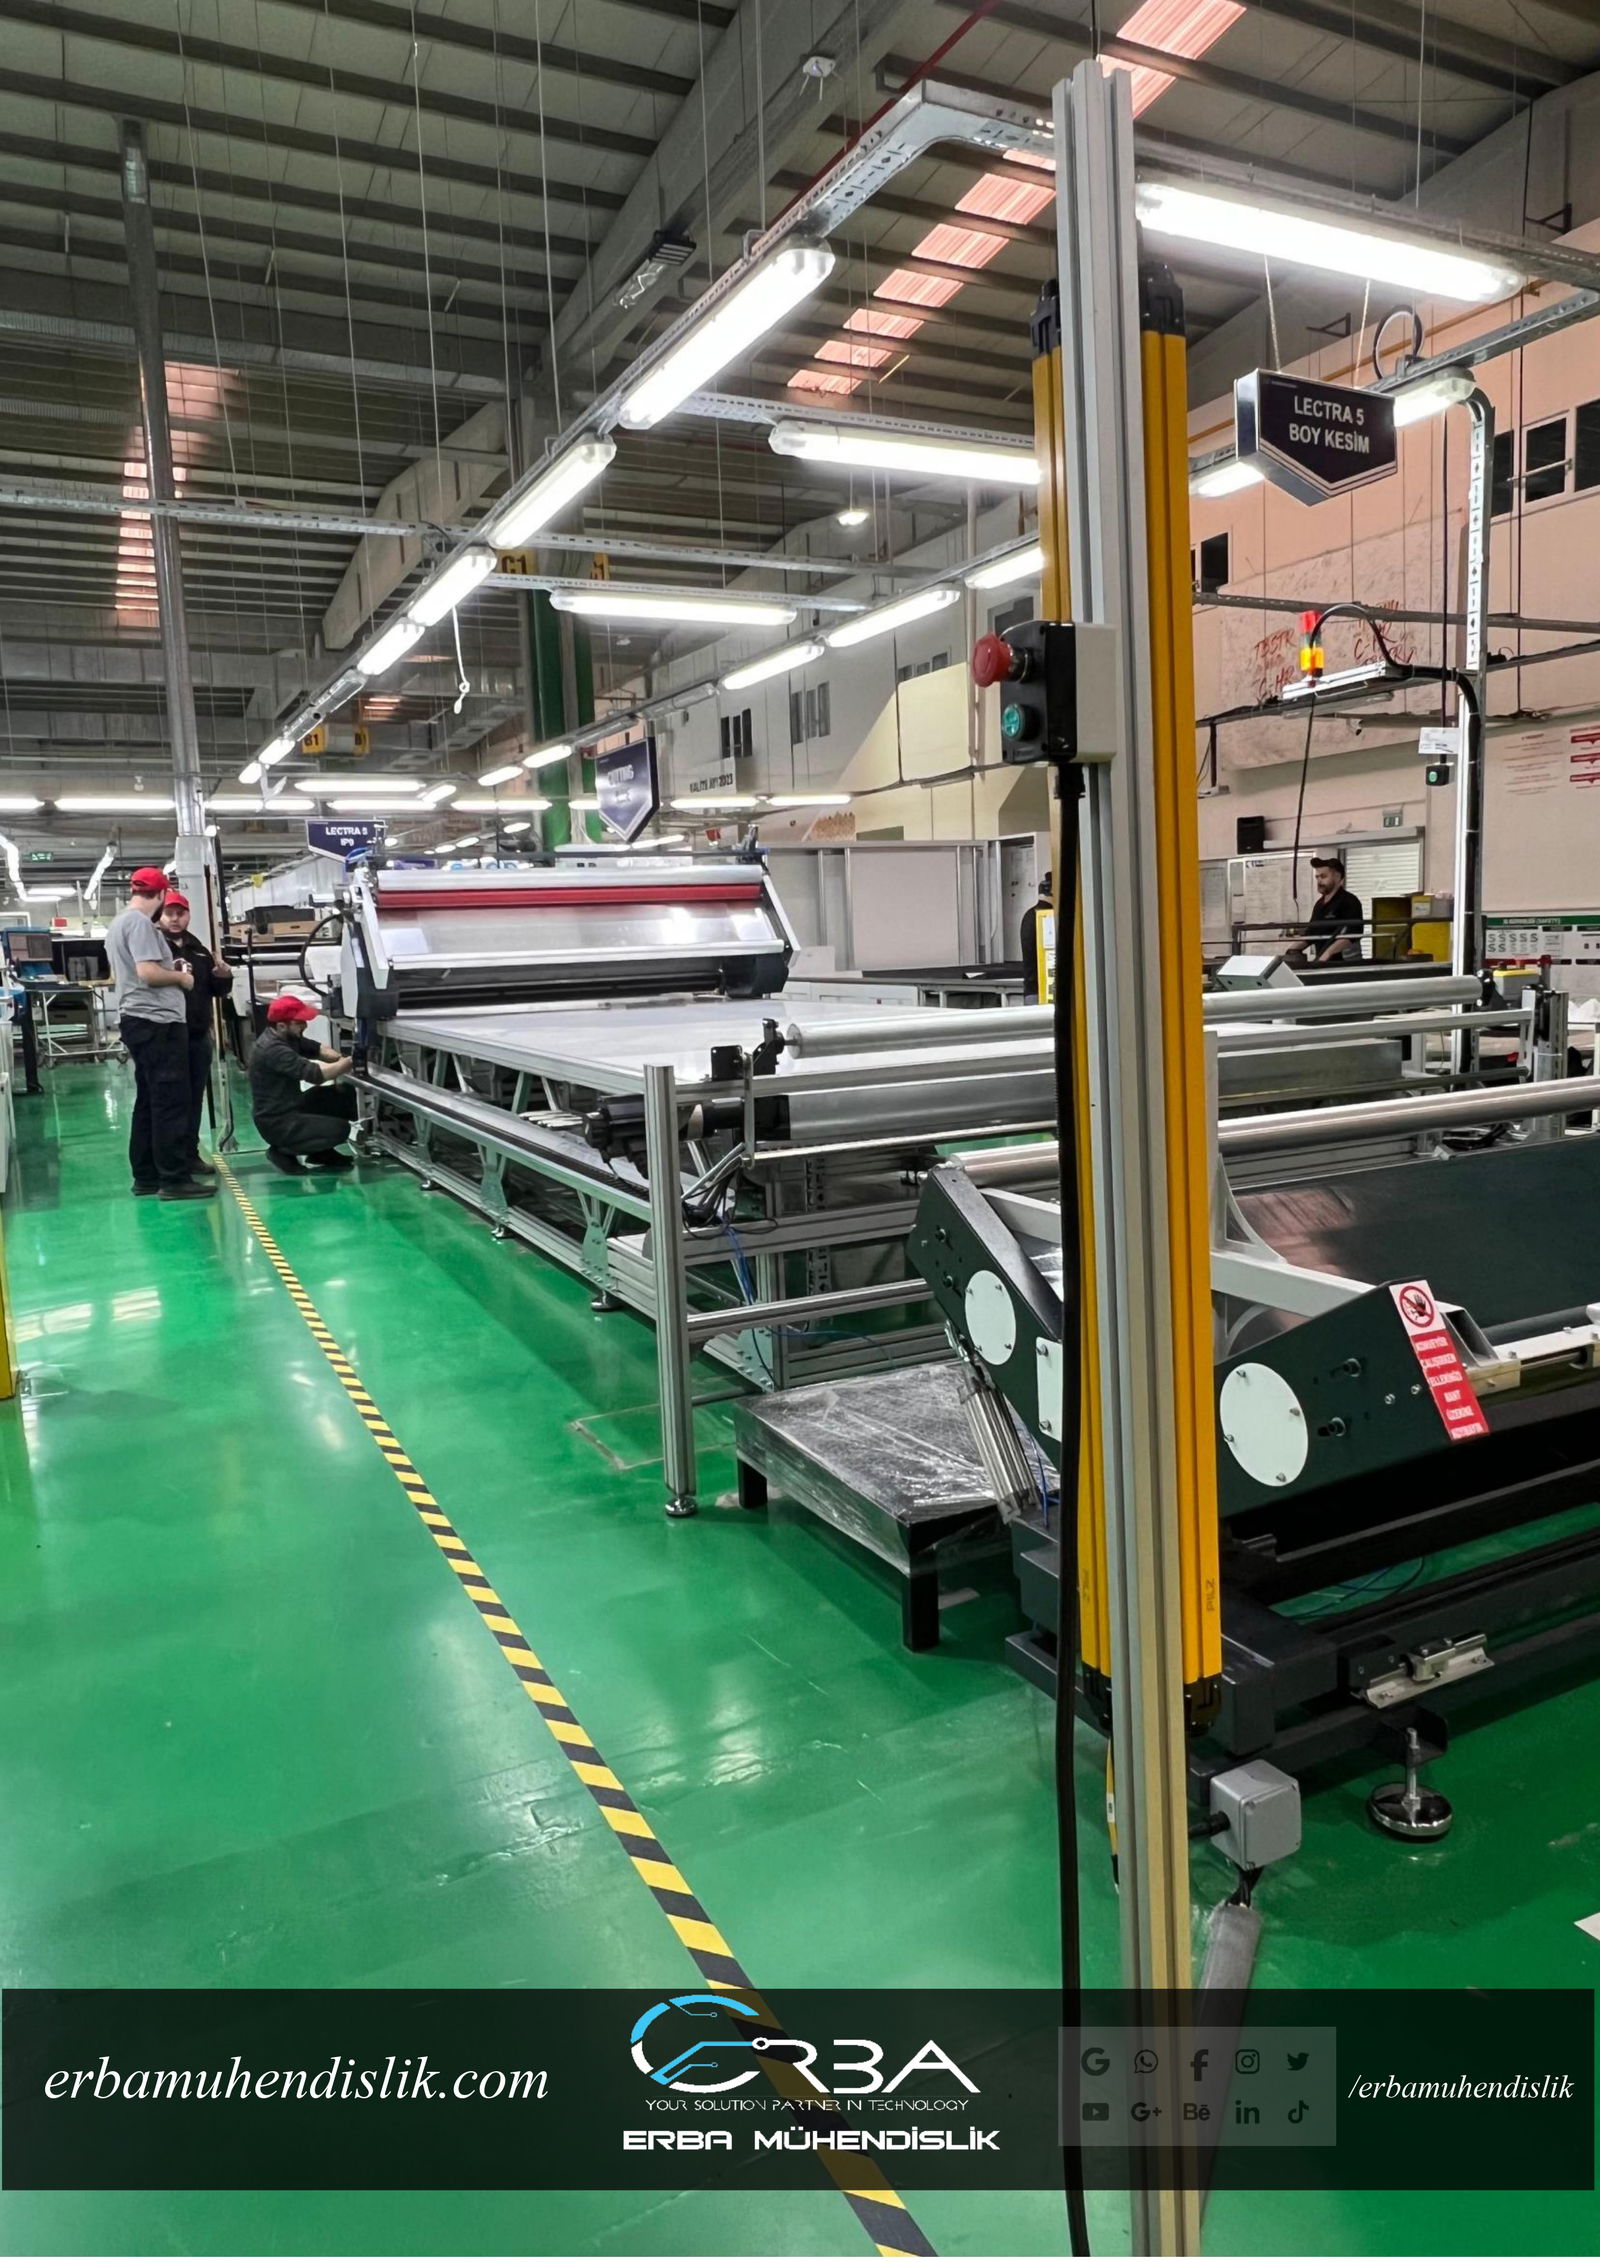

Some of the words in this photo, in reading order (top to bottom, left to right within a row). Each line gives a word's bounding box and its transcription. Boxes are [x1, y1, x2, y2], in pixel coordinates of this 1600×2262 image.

[1294, 395, 1353, 424] LECTRA
[1356, 408, 1365, 426] 5
[1289, 423, 1321, 445] BOY
[1324, 429, 1370, 454] KESİM
[325, 826, 361, 836] LECTRA
[1206, 1578, 1216, 1612] PILZ
